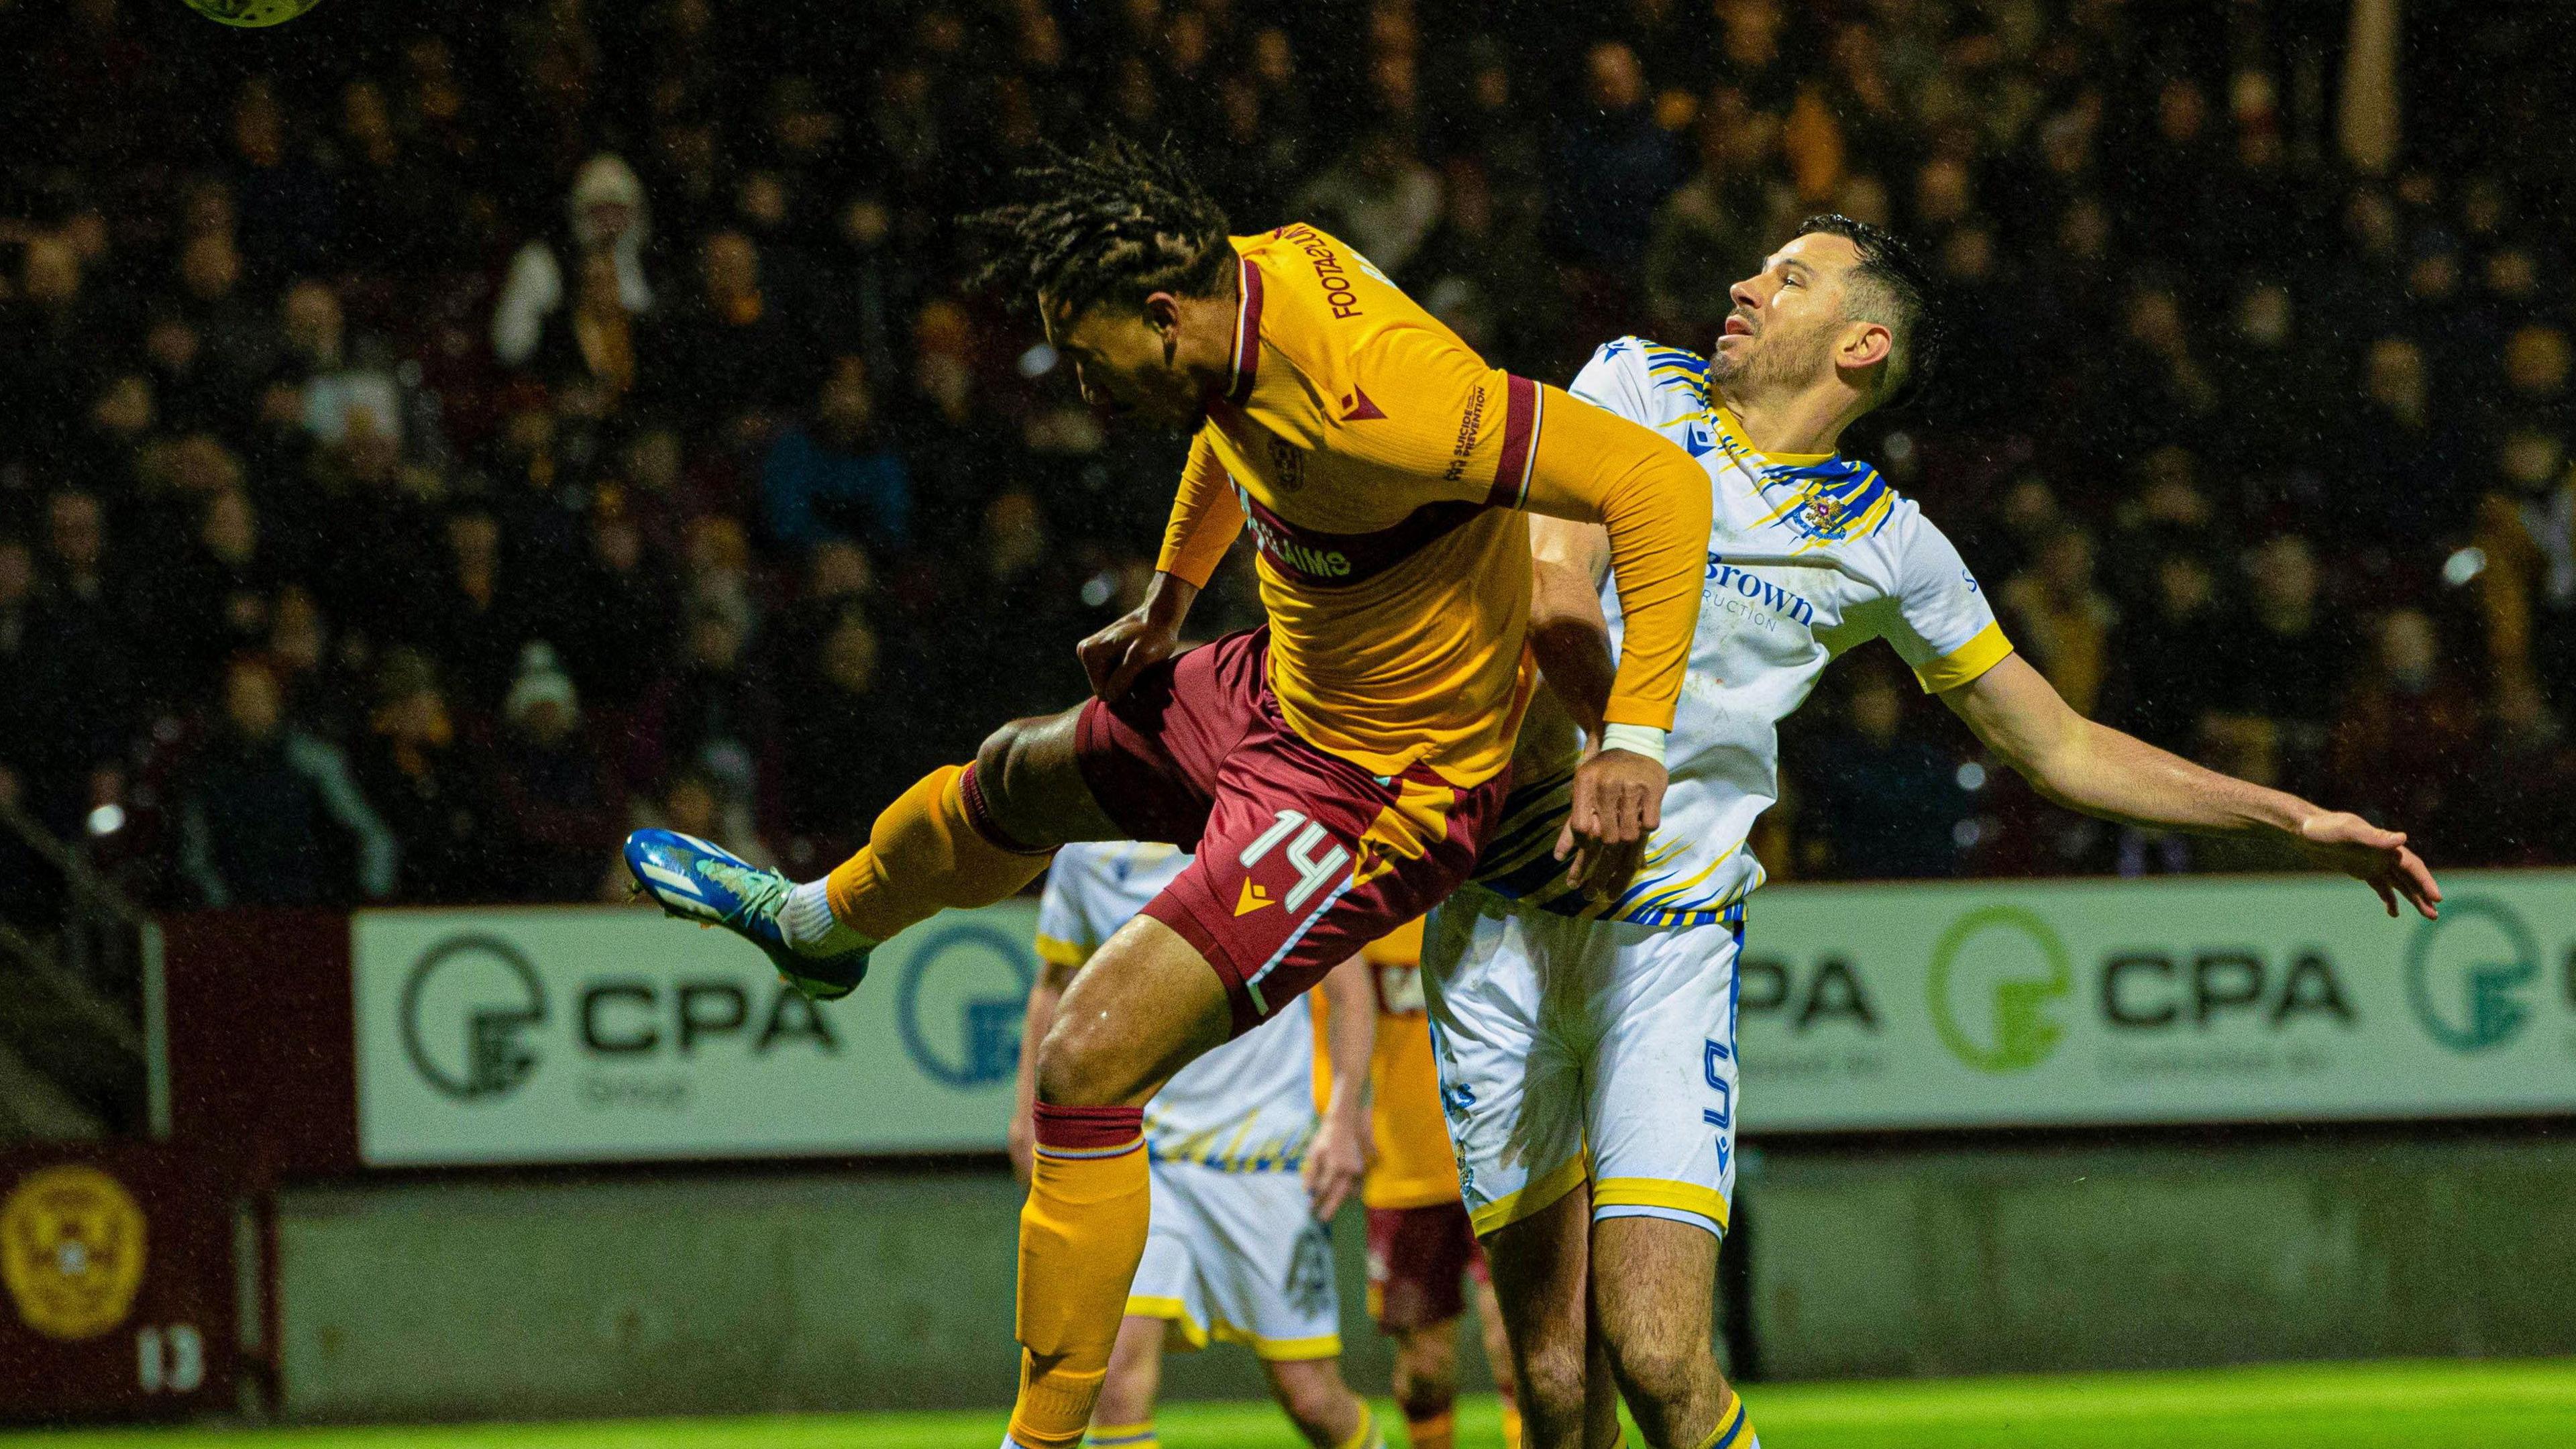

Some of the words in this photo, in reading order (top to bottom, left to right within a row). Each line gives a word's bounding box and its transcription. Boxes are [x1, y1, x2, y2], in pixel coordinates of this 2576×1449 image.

[1453, 409, 1473, 456] SUICIDE
[1462, 386, 1485, 457] PREVENTION
[1702, 589, 1778, 633] RUCTION
[1705, 550, 1814, 628] Brown
[1239, 809, 1350, 914] 14
[581, 980, 842, 1059] CPA
[1739, 957, 1881, 1036] PA
[2101, 949, 2360, 1031] CPA
[1703, 1037, 1731, 1130] 5
